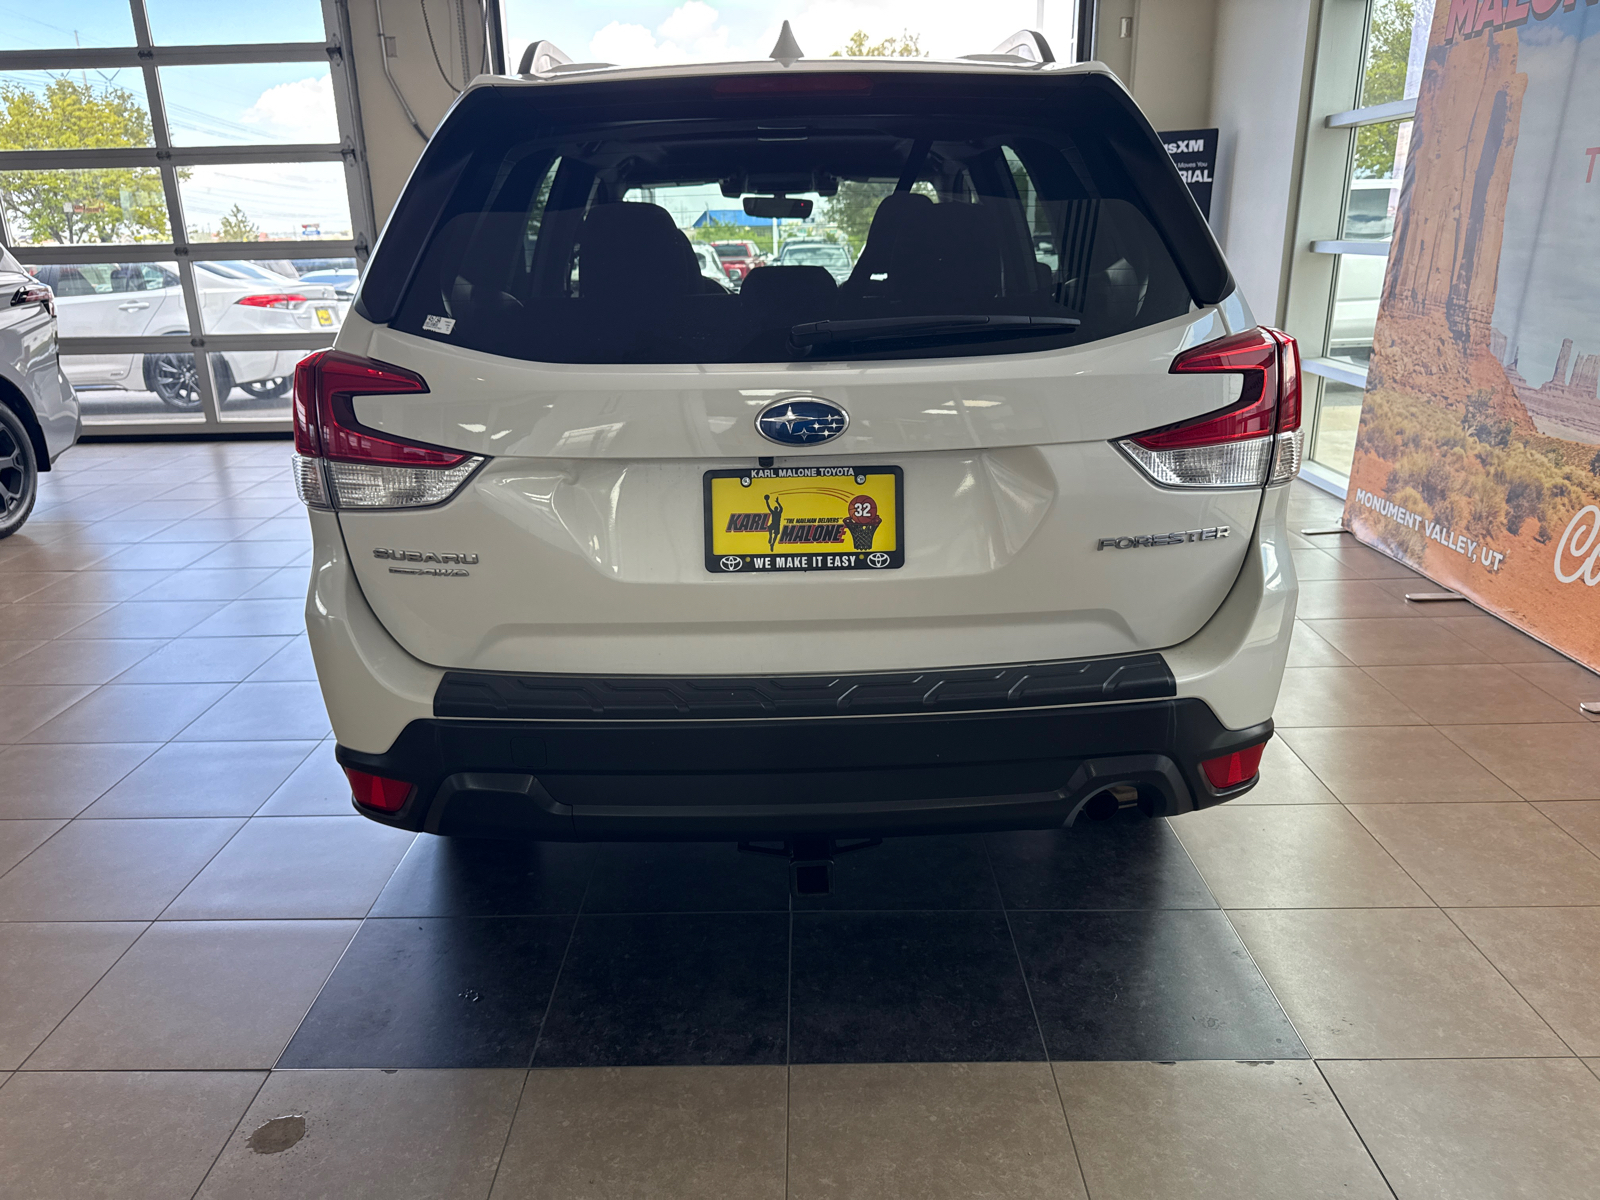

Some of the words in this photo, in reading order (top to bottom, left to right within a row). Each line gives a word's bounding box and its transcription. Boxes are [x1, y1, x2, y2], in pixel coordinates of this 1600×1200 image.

[751, 469, 776, 479] KARL
[778, 468, 818, 478] MALONE
[819, 467, 855, 477] TOYOTA
[854, 503, 871, 517] 32
[725, 513, 771, 533] KARL
[1355, 487, 1424, 533] MONUMENT
[1424, 519, 1478, 564] VALLEY,
[1480, 550, 1504, 571] UT
[778, 524, 846, 544] MALONE
[1097, 525, 1231, 551] FORESTER
[373, 548, 479, 565] SUBARU
[754, 556, 771, 569] WE
[776, 556, 808, 569] MAKE
[812, 556, 823, 567] IT
[827, 555, 856, 567] EASY
